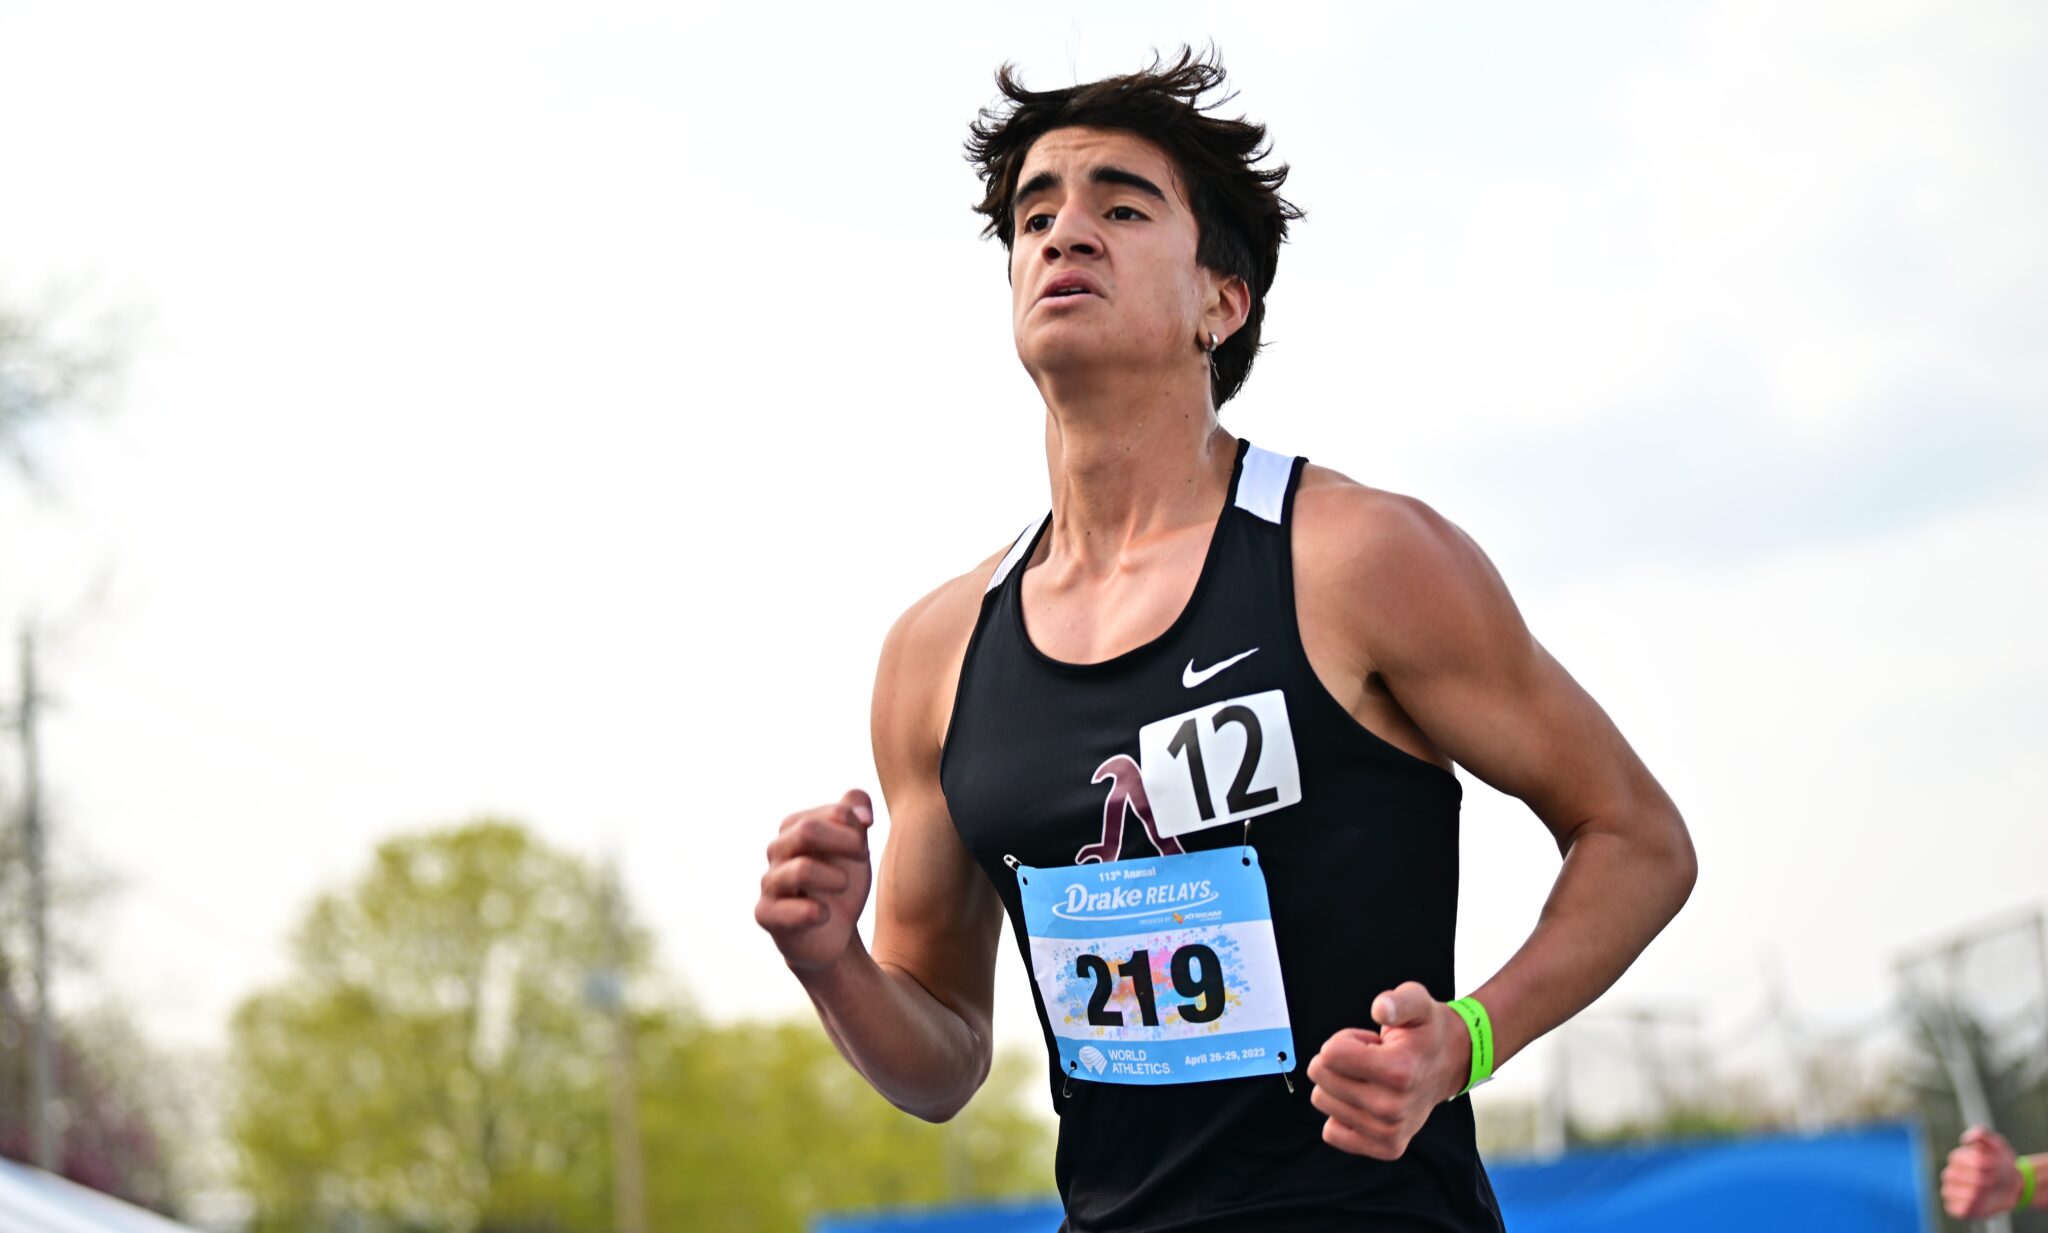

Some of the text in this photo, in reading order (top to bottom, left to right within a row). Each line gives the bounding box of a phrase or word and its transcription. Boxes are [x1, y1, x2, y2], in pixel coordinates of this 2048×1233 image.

[1167, 705, 1279, 821] 12
[1124, 867, 1156, 880] Annual
[1065, 880, 1211, 913] Drake RELAYS
[1076, 944, 1225, 1026] 219
[1108, 1049, 1147, 1062] WORLD
[1185, 1051, 1207, 1065] April
[1242, 1048, 1265, 1059] 2023
